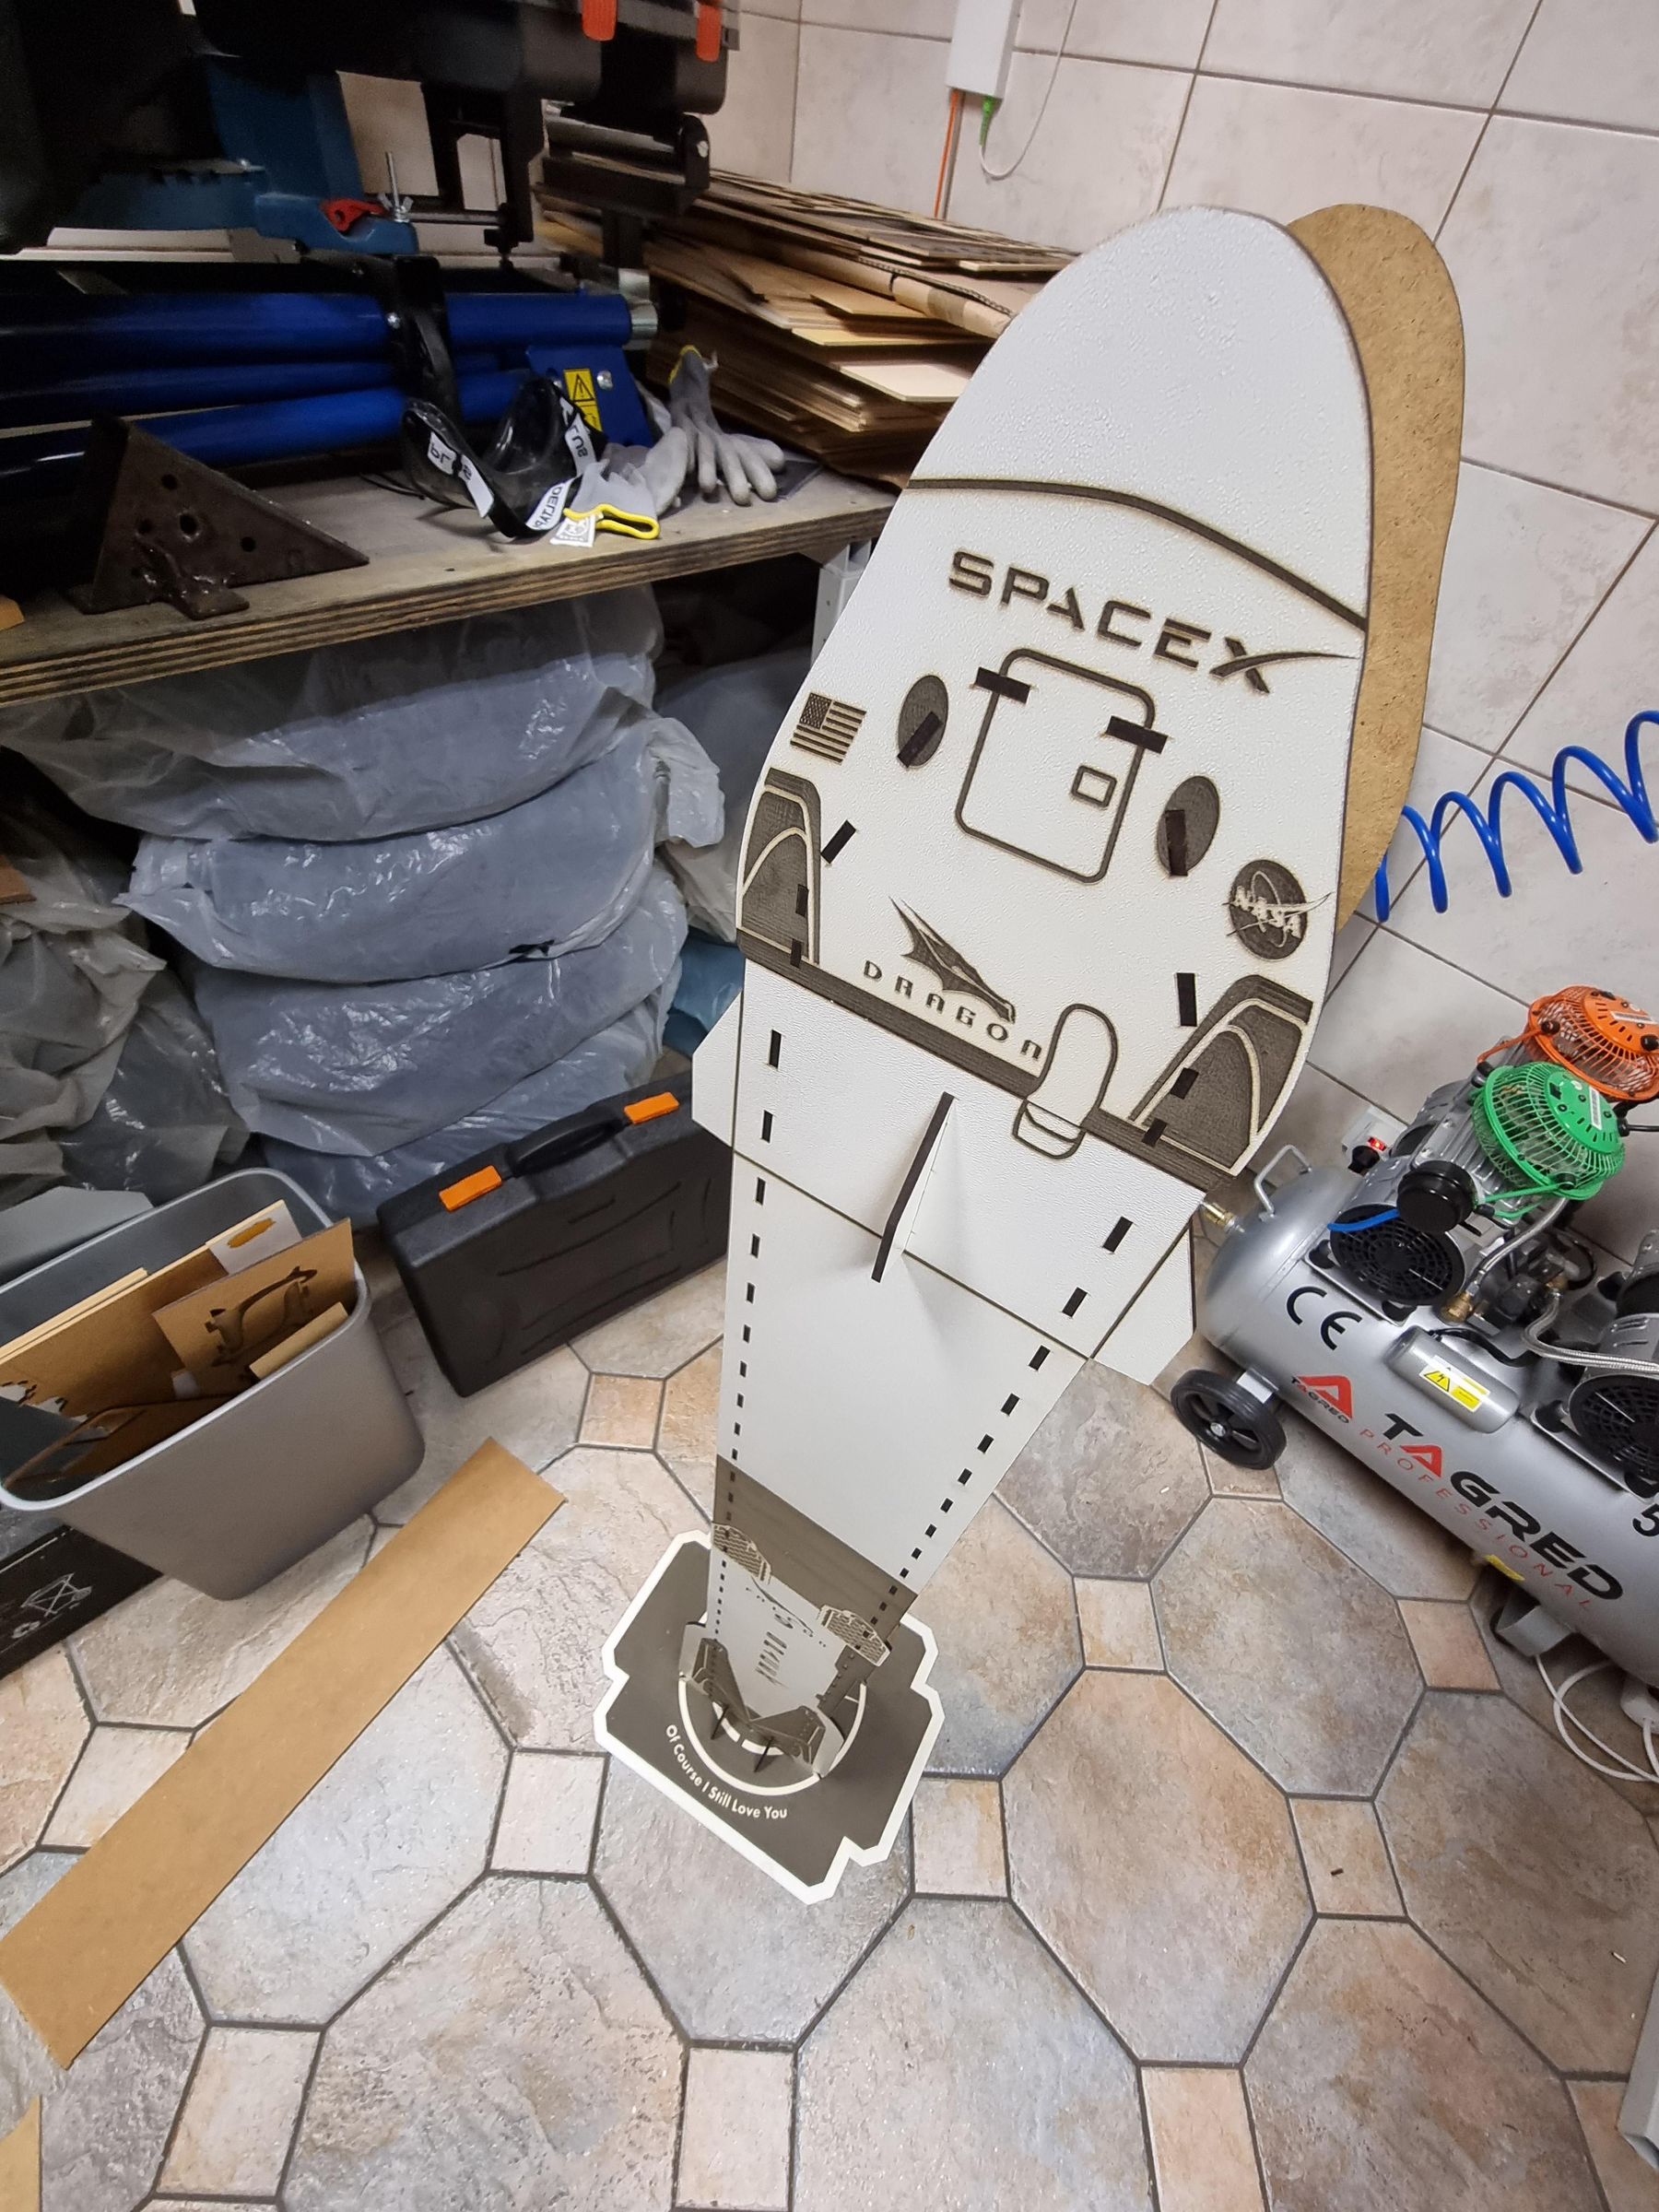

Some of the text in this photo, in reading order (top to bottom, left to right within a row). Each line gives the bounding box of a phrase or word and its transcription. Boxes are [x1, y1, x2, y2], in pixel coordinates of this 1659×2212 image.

[948, 550, 1359, 694] SPACEX
[864, 959, 1044, 1059] DRAGON
[1287, 1286, 1362, 1350] CE
[1291, 1376, 1349, 1423] TAGRED
[1359, 1429, 1594, 1609] PROFESSIONAL
[1382, 1413, 1623, 1600] TAGRED
[666, 1724, 788, 1819] Of Course I Still Love You
